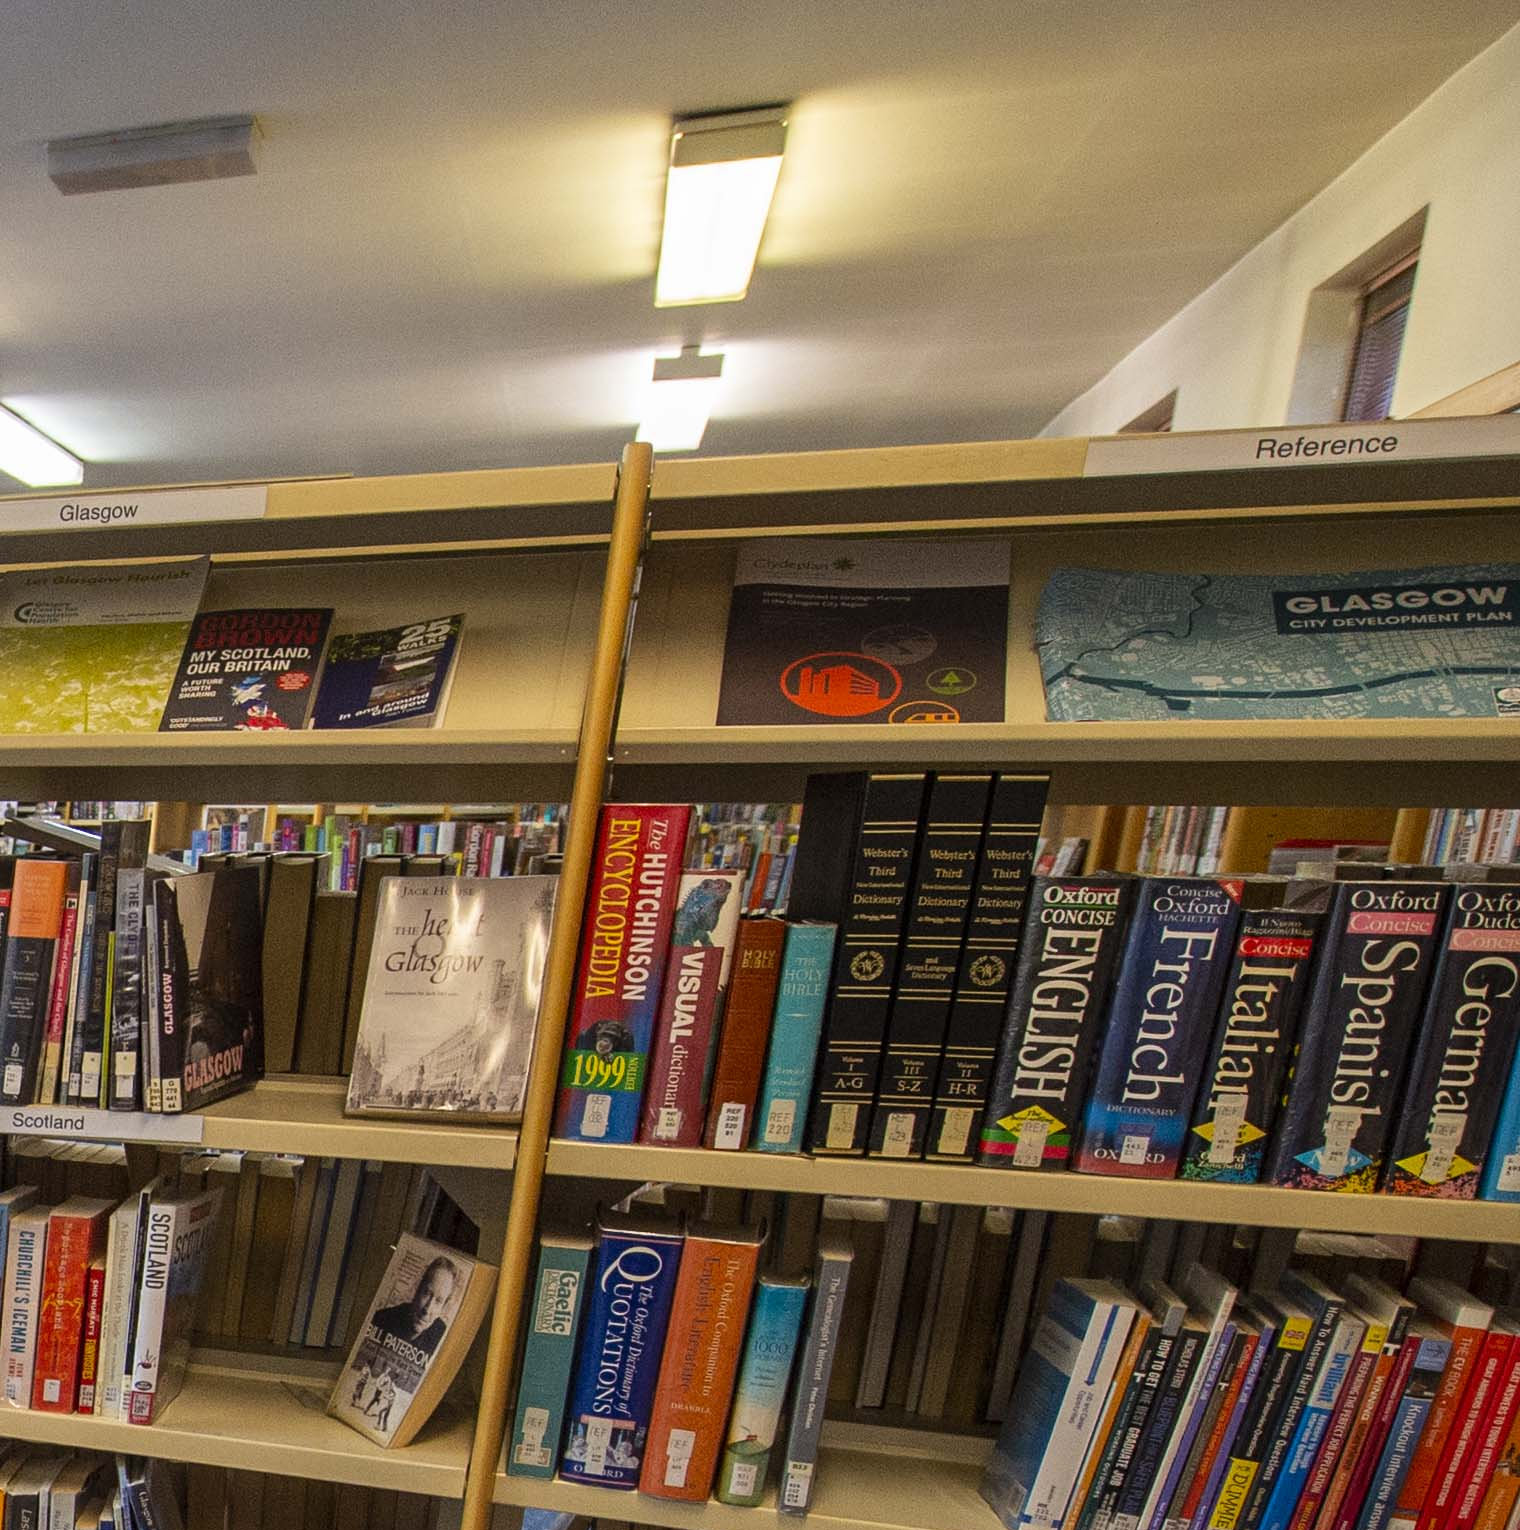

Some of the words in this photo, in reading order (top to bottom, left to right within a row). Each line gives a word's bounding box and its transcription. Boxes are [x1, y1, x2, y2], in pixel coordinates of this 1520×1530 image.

[1256, 432, 1398, 460] Reference
[60, 502, 139, 523] Glasgow
[1286, 587, 1507, 614] GLASGOW
[400, 619, 451, 640] 25
[1289, 619, 1327, 628] CITY
[1332, 613, 1461, 627] DEVELOPMENT
[1466, 611, 1512, 622] PLAN
[397, 635, 449, 652] WALKS
[190, 651, 218, 663] MY
[220, 647, 312, 661] SCOTLAND,
[186, 662, 221, 675] OUR
[224, 659, 291, 674] BRITAIN
[178, 691, 217, 700] SHARING
[649, 819, 669, 851] The
[863, 848, 908, 858] Webster's
[929, 850, 976, 860] Webster's
[986, 850, 1033, 860] Webster's
[869, 866, 896, 876] Third
[935, 869, 963, 878] Third
[992, 869, 1020, 879] Third
[853, 895, 903, 905] Dictionary
[918, 896, 968, 907] Dictionary
[1043, 885, 1120, 906] Oxford
[1166, 885, 1223, 899] Concise
[1350, 889, 1441, 910] Oxford
[585, 818, 642, 999] ENCYCLOPEDIA
[977, 897, 1023, 909] Dictionary
[1153, 898, 1231, 916] Oxford
[623, 852, 667, 1000] HUTCHINSON
[1040, 908, 1115, 927] CONCISE
[1348, 916, 1430, 933] Concise
[744, 950, 776, 960] HOLY
[1239, 938, 1309, 956] Concise
[669, 951, 705, 1043] VISUAL
[782, 983, 823, 997] BIBLE
[164, 972, 173, 1034] GLASGOW
[1010, 926, 1105, 1102] ENGLISH
[1122, 925, 1219, 1104] French
[1437, 956, 1520, 1141] Germa
[665, 1044, 688, 1113] dictionar
[1106, 1104, 1176, 1116] DICTIONARY
[12, 1112, 85, 1130] Scotland
[145, 1213, 171, 1289] SCOTLAND
[13, 1231, 35, 1304] CHURCHILL'S
[552, 1272, 578, 1333] Gaelic
[637, 1285, 653, 1305] The
[629, 1308, 649, 1345] Oxford
[1322, 1307, 1338, 1325] How
[9, 1308, 28, 1354] ICEMAN
[592, 1246, 663, 1415] QUOTATIONS
[1318, 1327, 1331, 1338] To
[365, 1324, 384, 1344] BILL
[383, 1333, 431, 1368] PATERSON
[1305, 1339, 1326, 1371] Answer
[619, 1347, 641, 1401] Dictionary
[1296, 1374, 1314, 1394] Hard
[1317, 1353, 1351, 1402] brilliant
[616, 1403, 632, 1417] of
[1280, 1396, 1305, 1436] Interview
[1395, 1404, 1424, 1453] Knockout
[1262, 1439, 1291, 1481] Questions
[1376, 1455, 1405, 1502] interview
